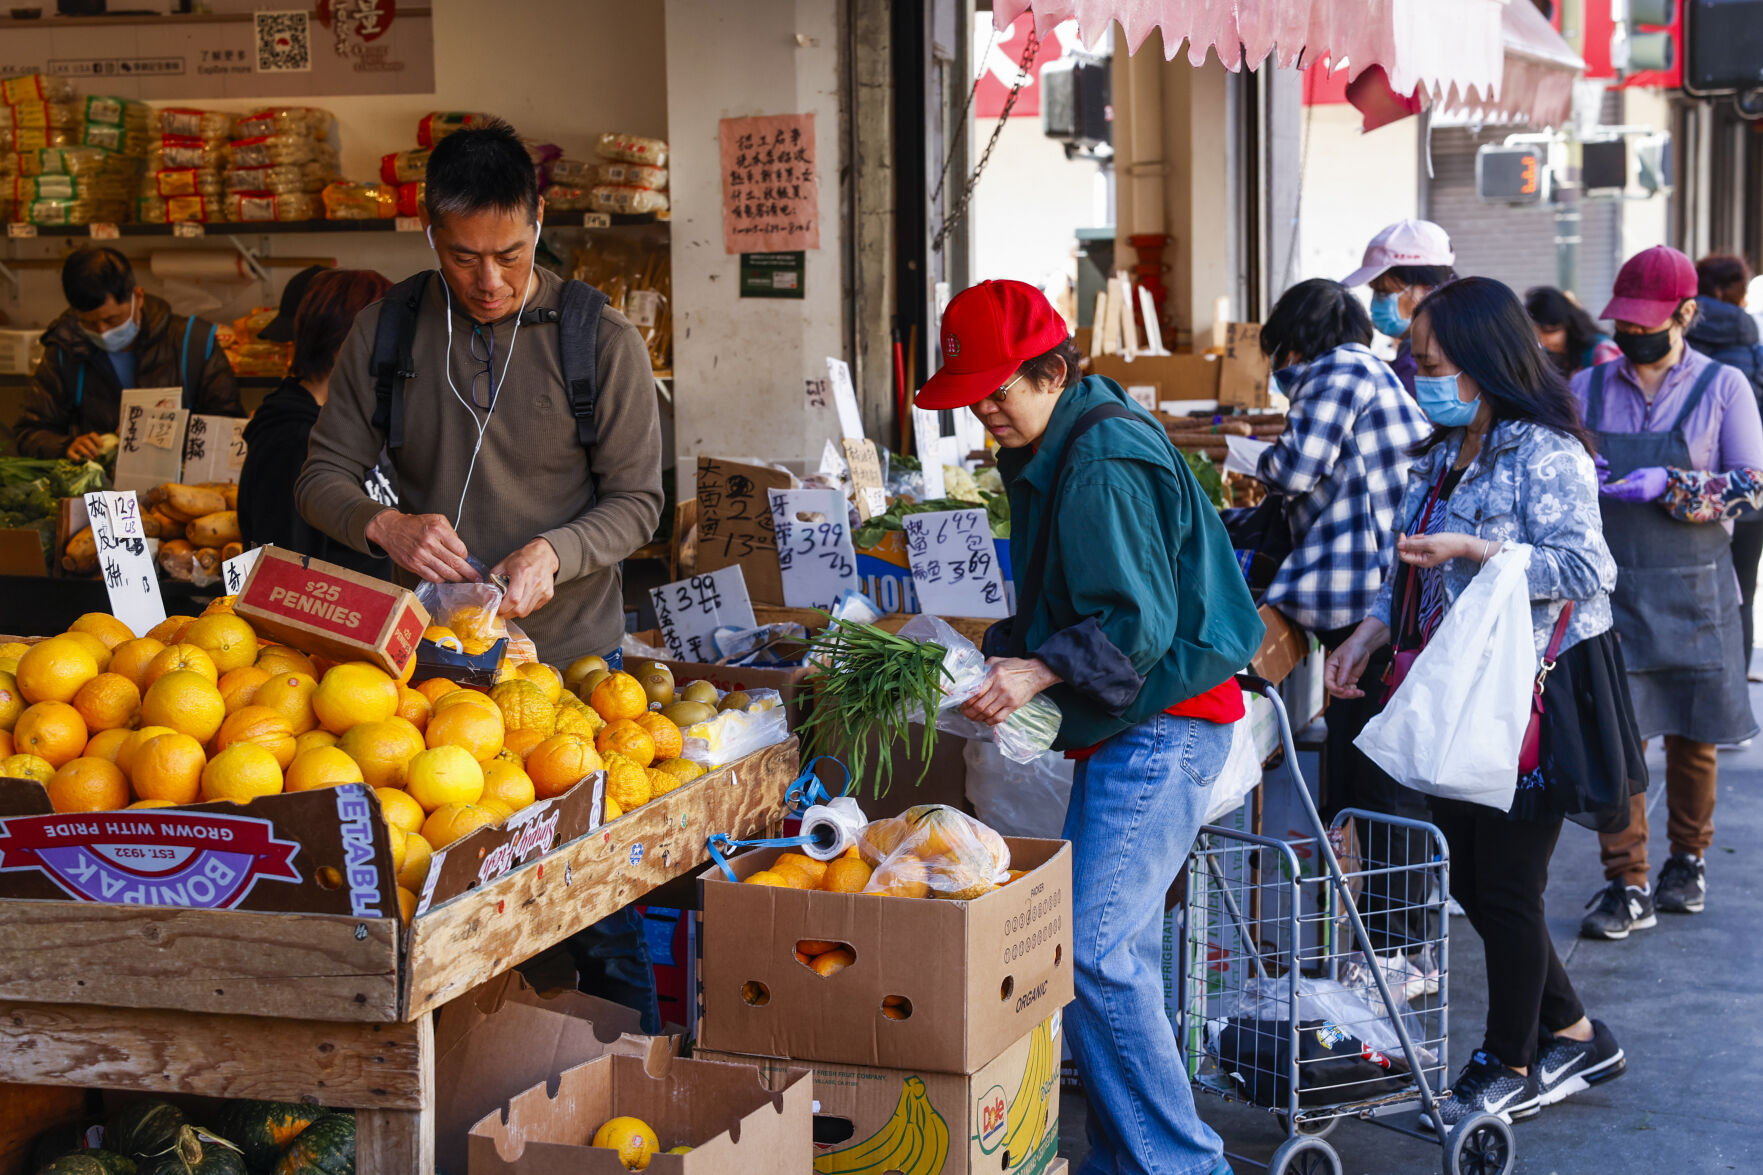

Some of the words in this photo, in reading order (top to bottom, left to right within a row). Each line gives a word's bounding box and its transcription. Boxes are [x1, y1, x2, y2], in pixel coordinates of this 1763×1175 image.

[305, 580, 343, 602] $25
[268, 586, 363, 630] PENNIES
[43, 822, 98, 839] PRIDE
[105, 822, 155, 836] WITH
[160, 822, 234, 842] GROWN
[518, 812, 559, 852] Simply
[113, 846, 146, 859] 1932
[148, 847, 176, 860] EST.
[481, 842, 517, 880] Fresh
[64, 852, 236, 906] BONIPAK
[1162, 910, 1174, 998] REFRIGERATE
[1015, 980, 1049, 1014] ORGANIC
[817, 1069, 837, 1078] FRESH
[838, 1071, 856, 1079] FRUIT
[983, 1096, 1005, 1134] Dole
